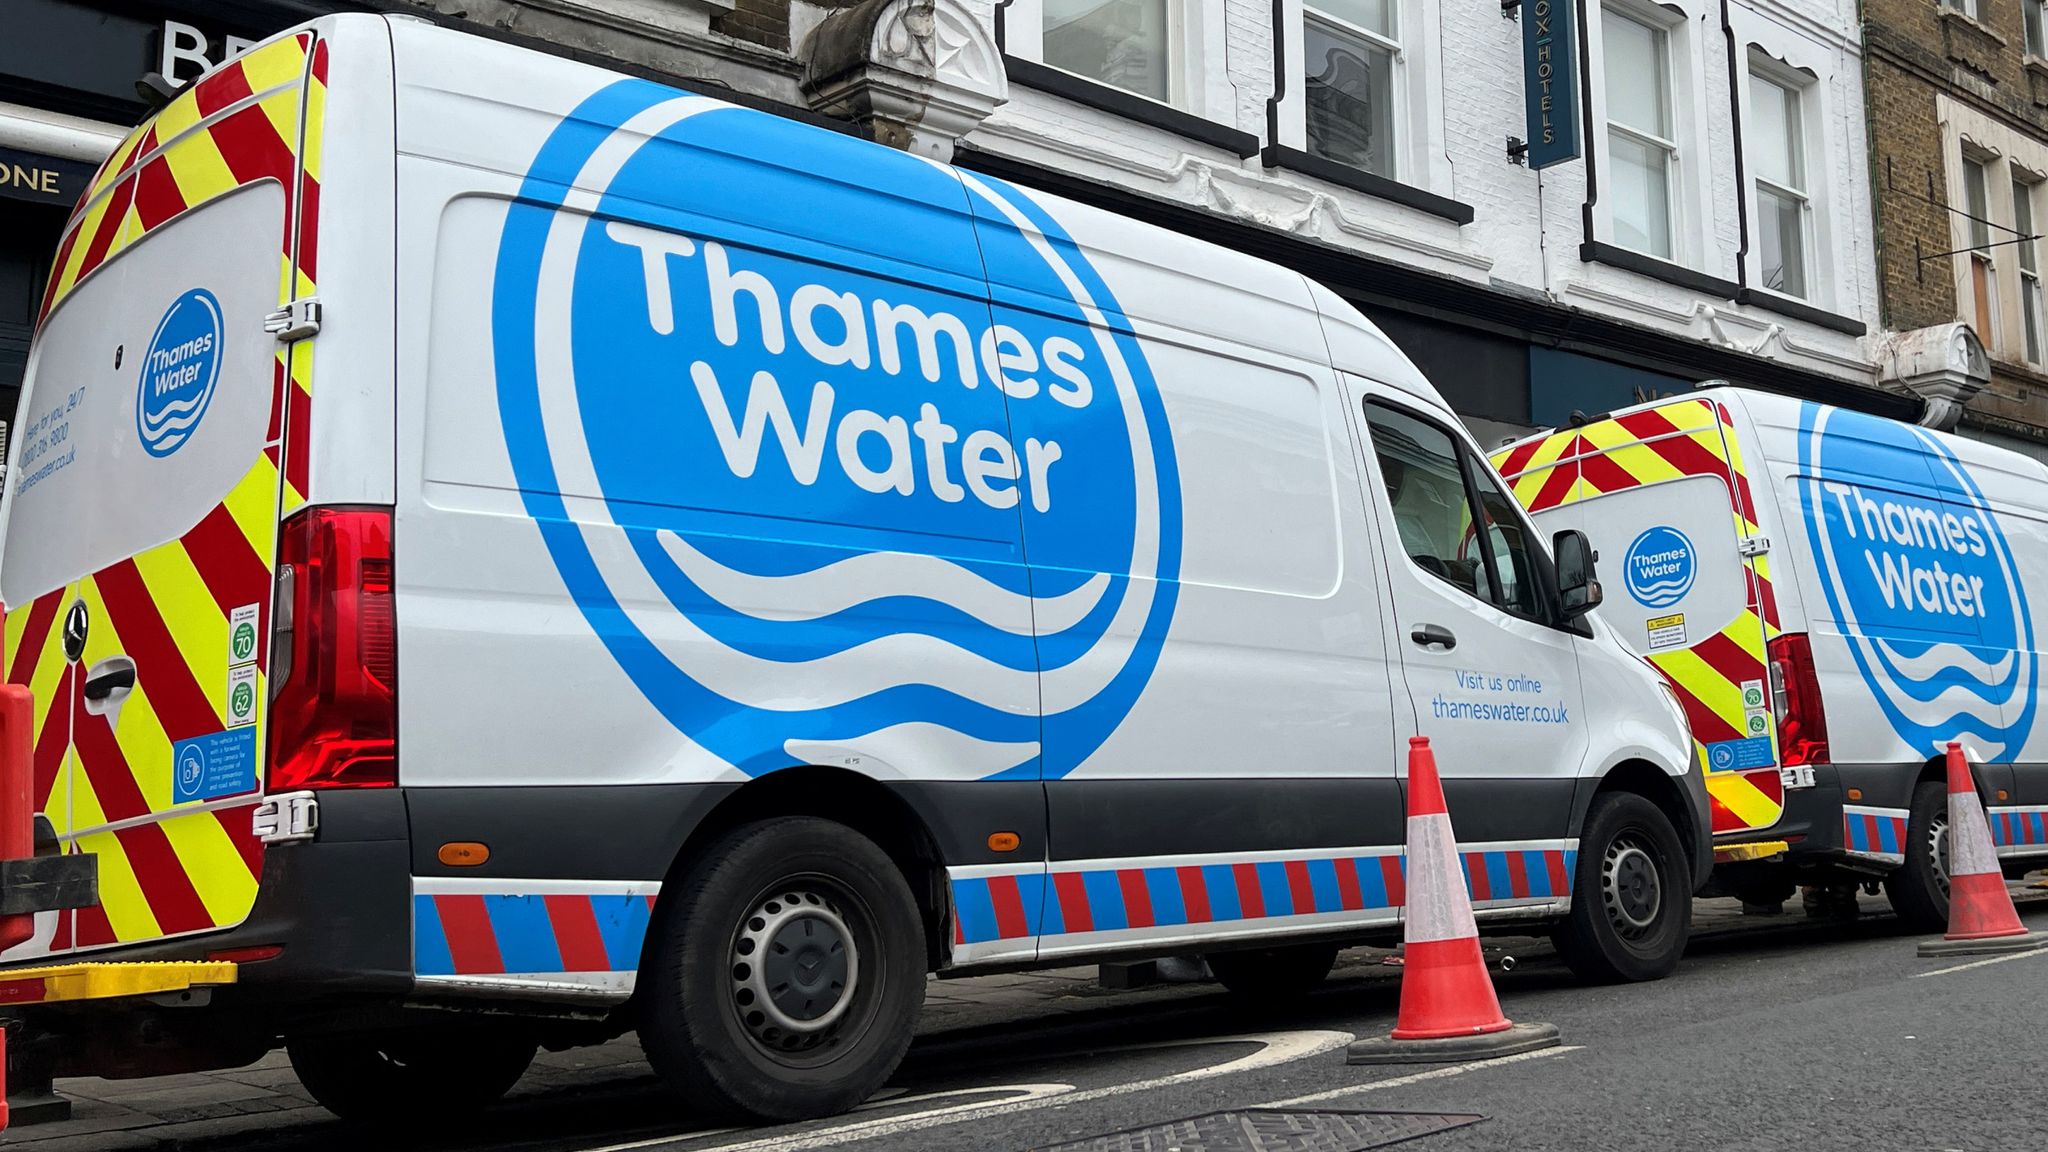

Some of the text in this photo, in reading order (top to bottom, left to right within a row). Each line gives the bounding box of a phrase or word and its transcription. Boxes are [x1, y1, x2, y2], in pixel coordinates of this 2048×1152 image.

[606, 221, 1094, 409] Thames
[152, 332, 213, 374] Thames
[154, 361, 202, 397] Water
[690, 360, 1063, 514] Water
[1824, 481, 1987, 557] Thames
[1633, 548, 1687, 568] Thames
[1640, 561, 1682, 580] Water
[1865, 549, 1986, 618] Water
[236, 635, 252, 656] 70
[1455, 669, 1542, 694] Visit us online
[235, 693, 249, 713] 62
[1432, 693, 1570, 724] thameswater.co.uk
